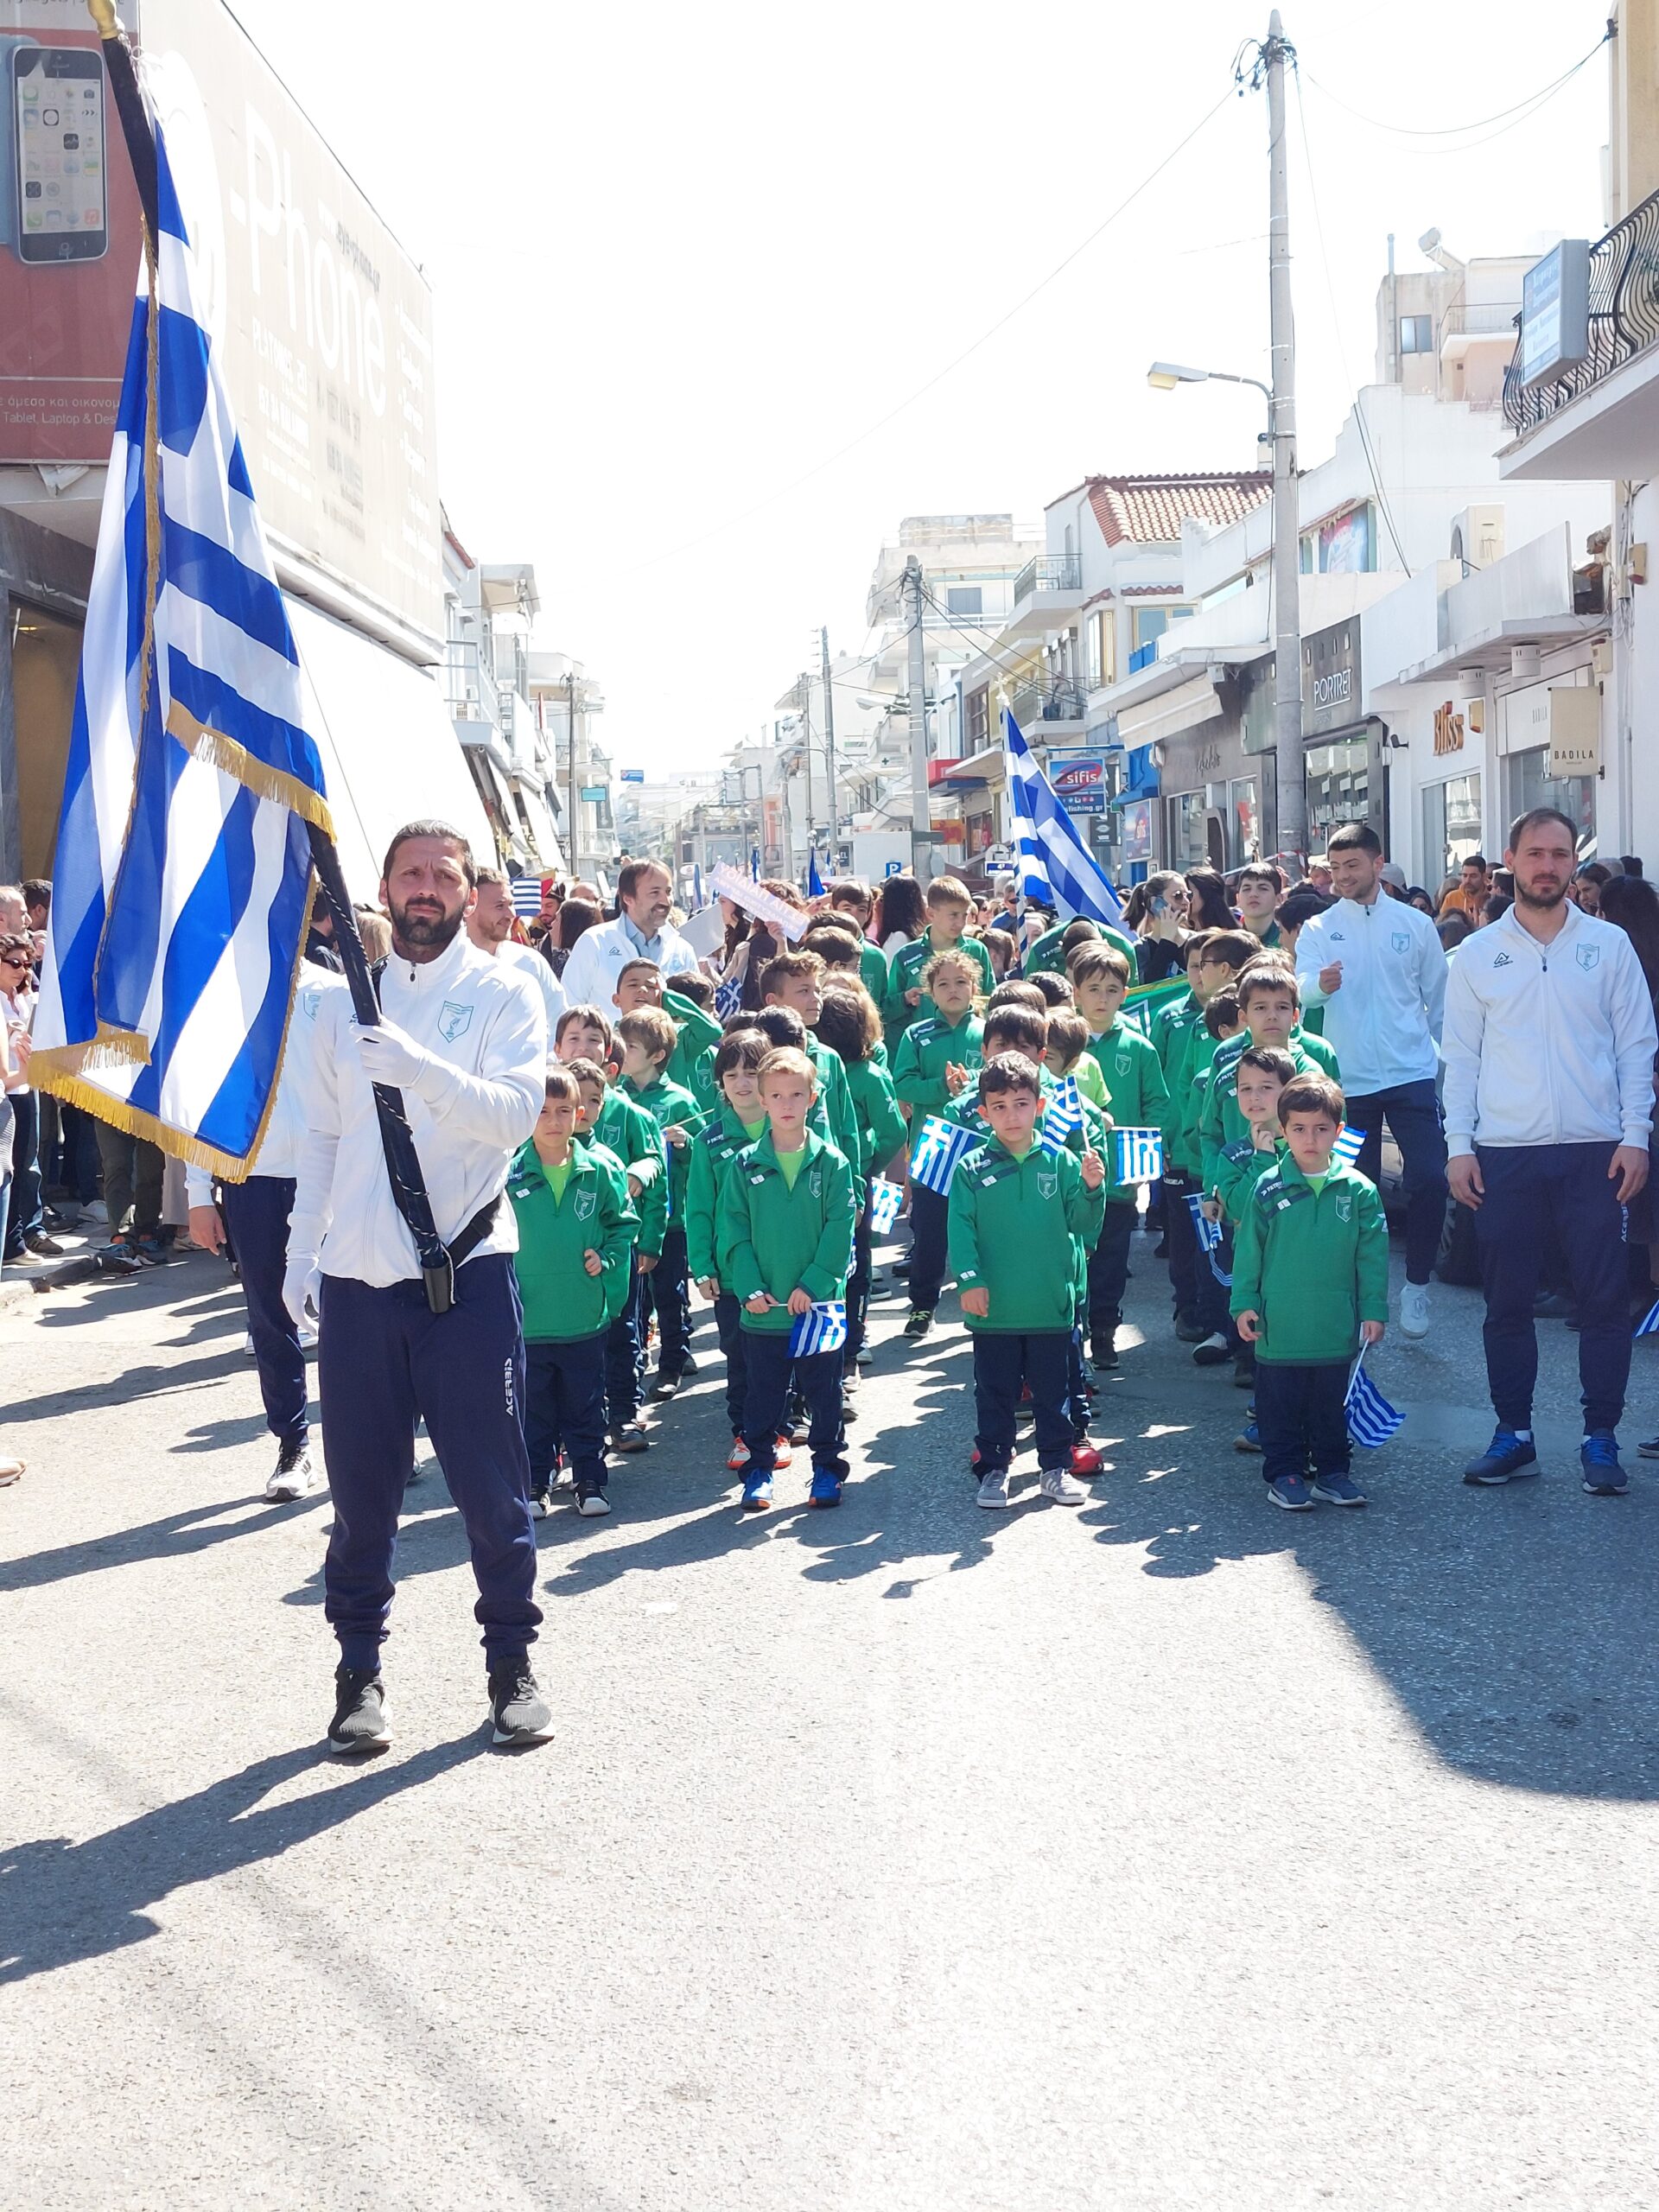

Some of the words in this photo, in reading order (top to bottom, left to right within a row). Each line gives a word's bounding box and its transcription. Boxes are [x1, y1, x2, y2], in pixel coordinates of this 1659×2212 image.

[50, 398, 68, 407] και
[41, 413, 80, 427] Laptop
[83, 414, 91, 424] &
[1314, 669, 1351, 705] PORTRET
[1433, 701, 1465, 756] Bliss
[1554, 750, 1594, 760] BADILA
[1066, 771, 1097, 785] sifis
